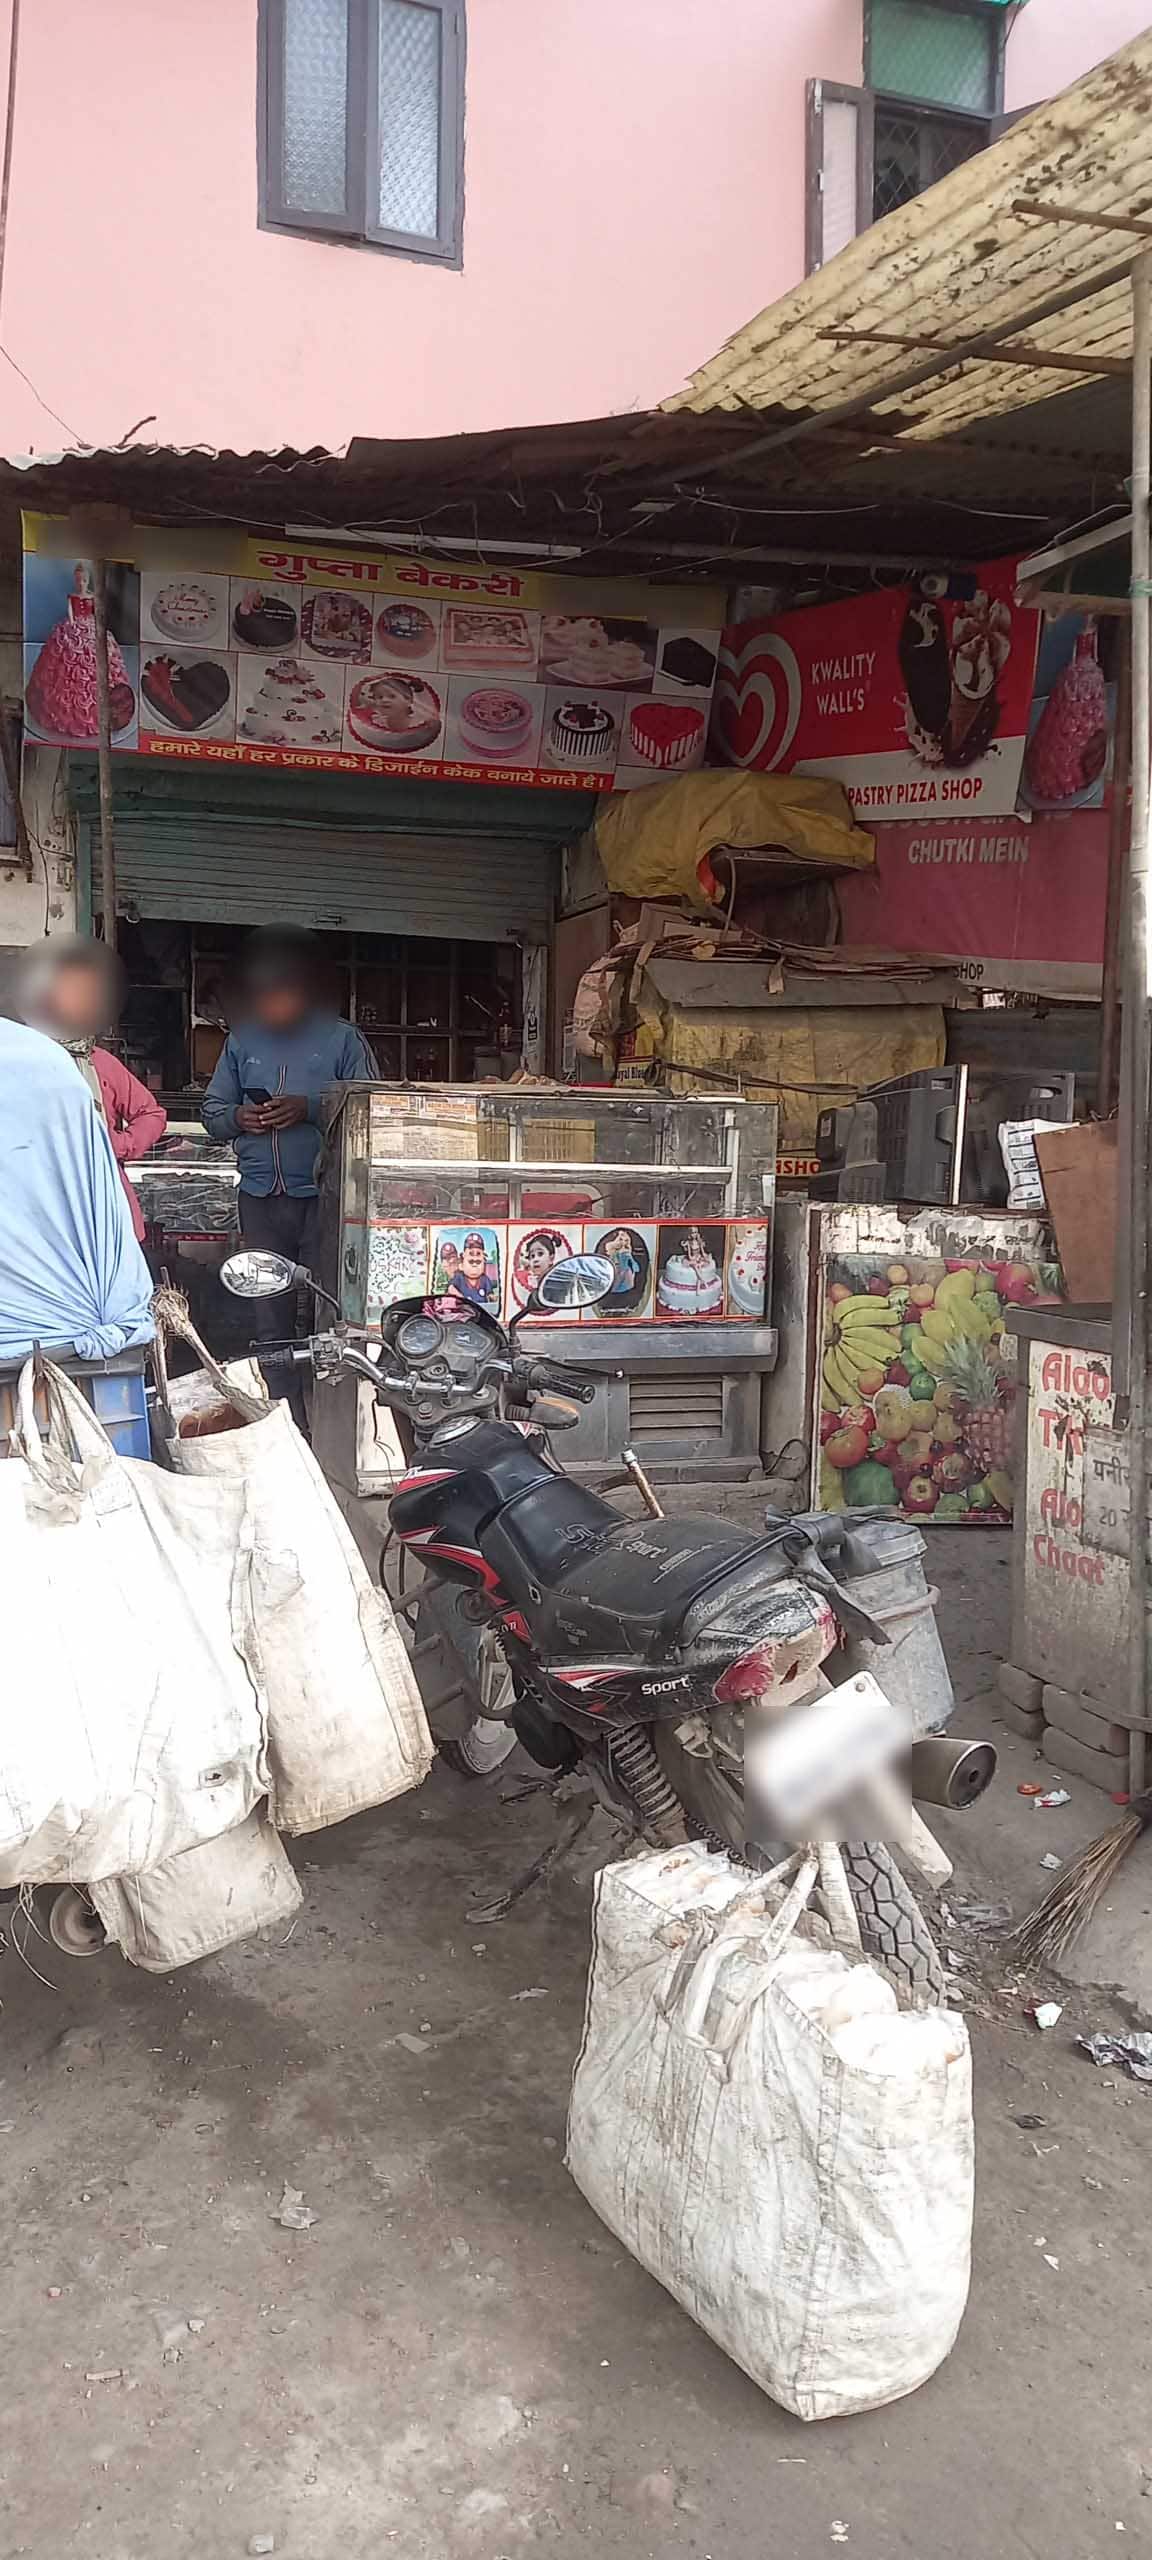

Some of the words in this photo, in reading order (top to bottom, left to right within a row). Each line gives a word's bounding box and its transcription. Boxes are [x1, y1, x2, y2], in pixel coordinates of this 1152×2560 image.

[257, 551, 383, 584] गुप्ता
[395, 562, 525, 597] बेकरी
[811, 652, 876, 685] KWALITY
[816, 688, 865, 716] WALL'S
[150, 739, 203, 755] हमारे
[206, 743, 244, 760] यहाँ
[249, 747, 277, 763] हर
[281, 753, 335, 767] प्रकार
[337, 753, 361, 770] के
[443, 763, 484, 779] केक
[540, 773, 579, 787] जाते
[848, 785, 893, 806] PASTRY
[897, 781, 937, 804] PIZZA
[941, 777, 983, 801] SHOP
[908, 837, 975, 864] CHUTKI
[978, 836, 1031, 864] MEIN
[1042, 1352, 1110, 1400] Aloo
[1099, 1505, 1117, 1527] 20
[641, 1677, 690, 1696] Sport
